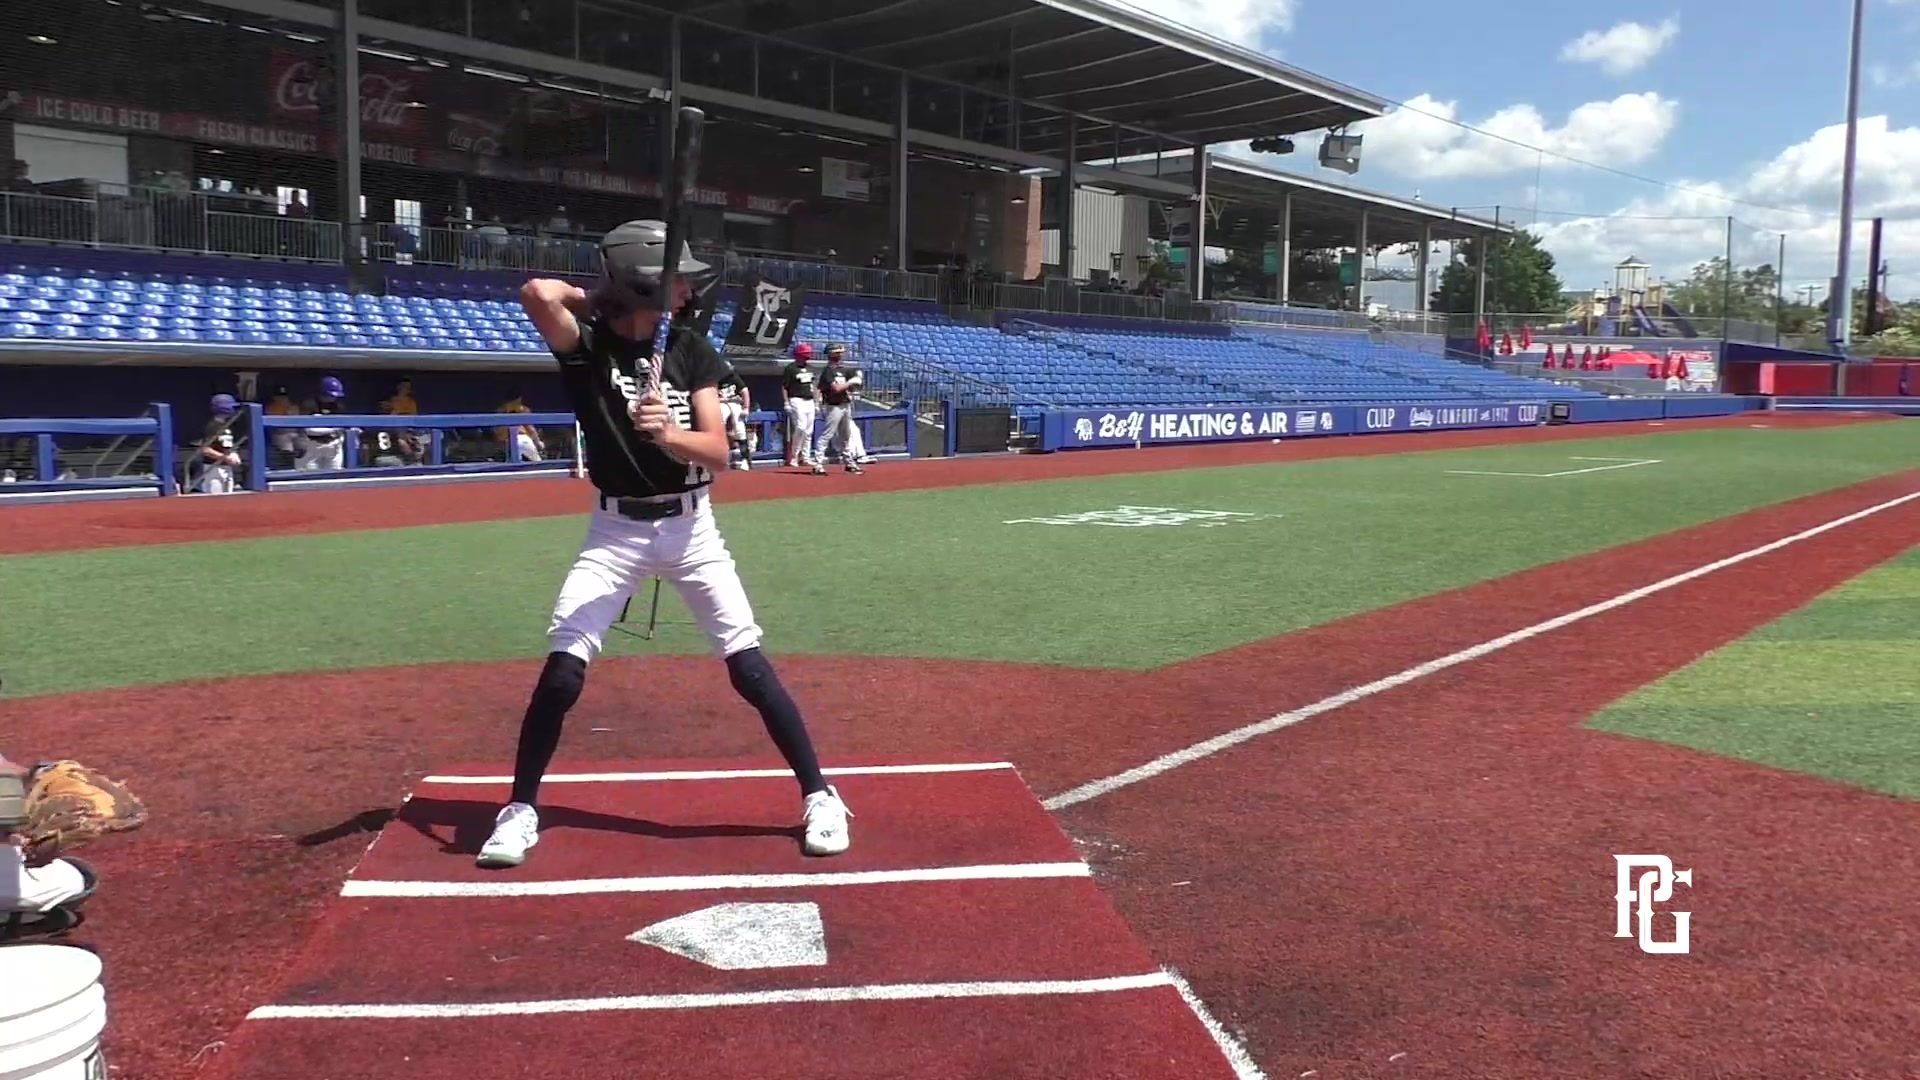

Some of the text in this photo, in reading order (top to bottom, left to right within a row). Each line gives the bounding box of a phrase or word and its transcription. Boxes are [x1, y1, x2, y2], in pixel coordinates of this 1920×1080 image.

[36, 96, 160, 130] ICE COLD BEER
[199, 119, 317, 152] FRESH CLASSICS
[359, 141, 416, 166] ARBEQUE
[746, 281, 791, 344] PG
[1150, 413, 1237, 438] HEATING
[1240, 411, 1254, 435] &
[1258, 411, 1288, 434] AIR
[1366, 408, 1396, 428] CULP
[1436, 408, 1478, 424] COMFORT
[1517, 405, 1539, 422] CULP
